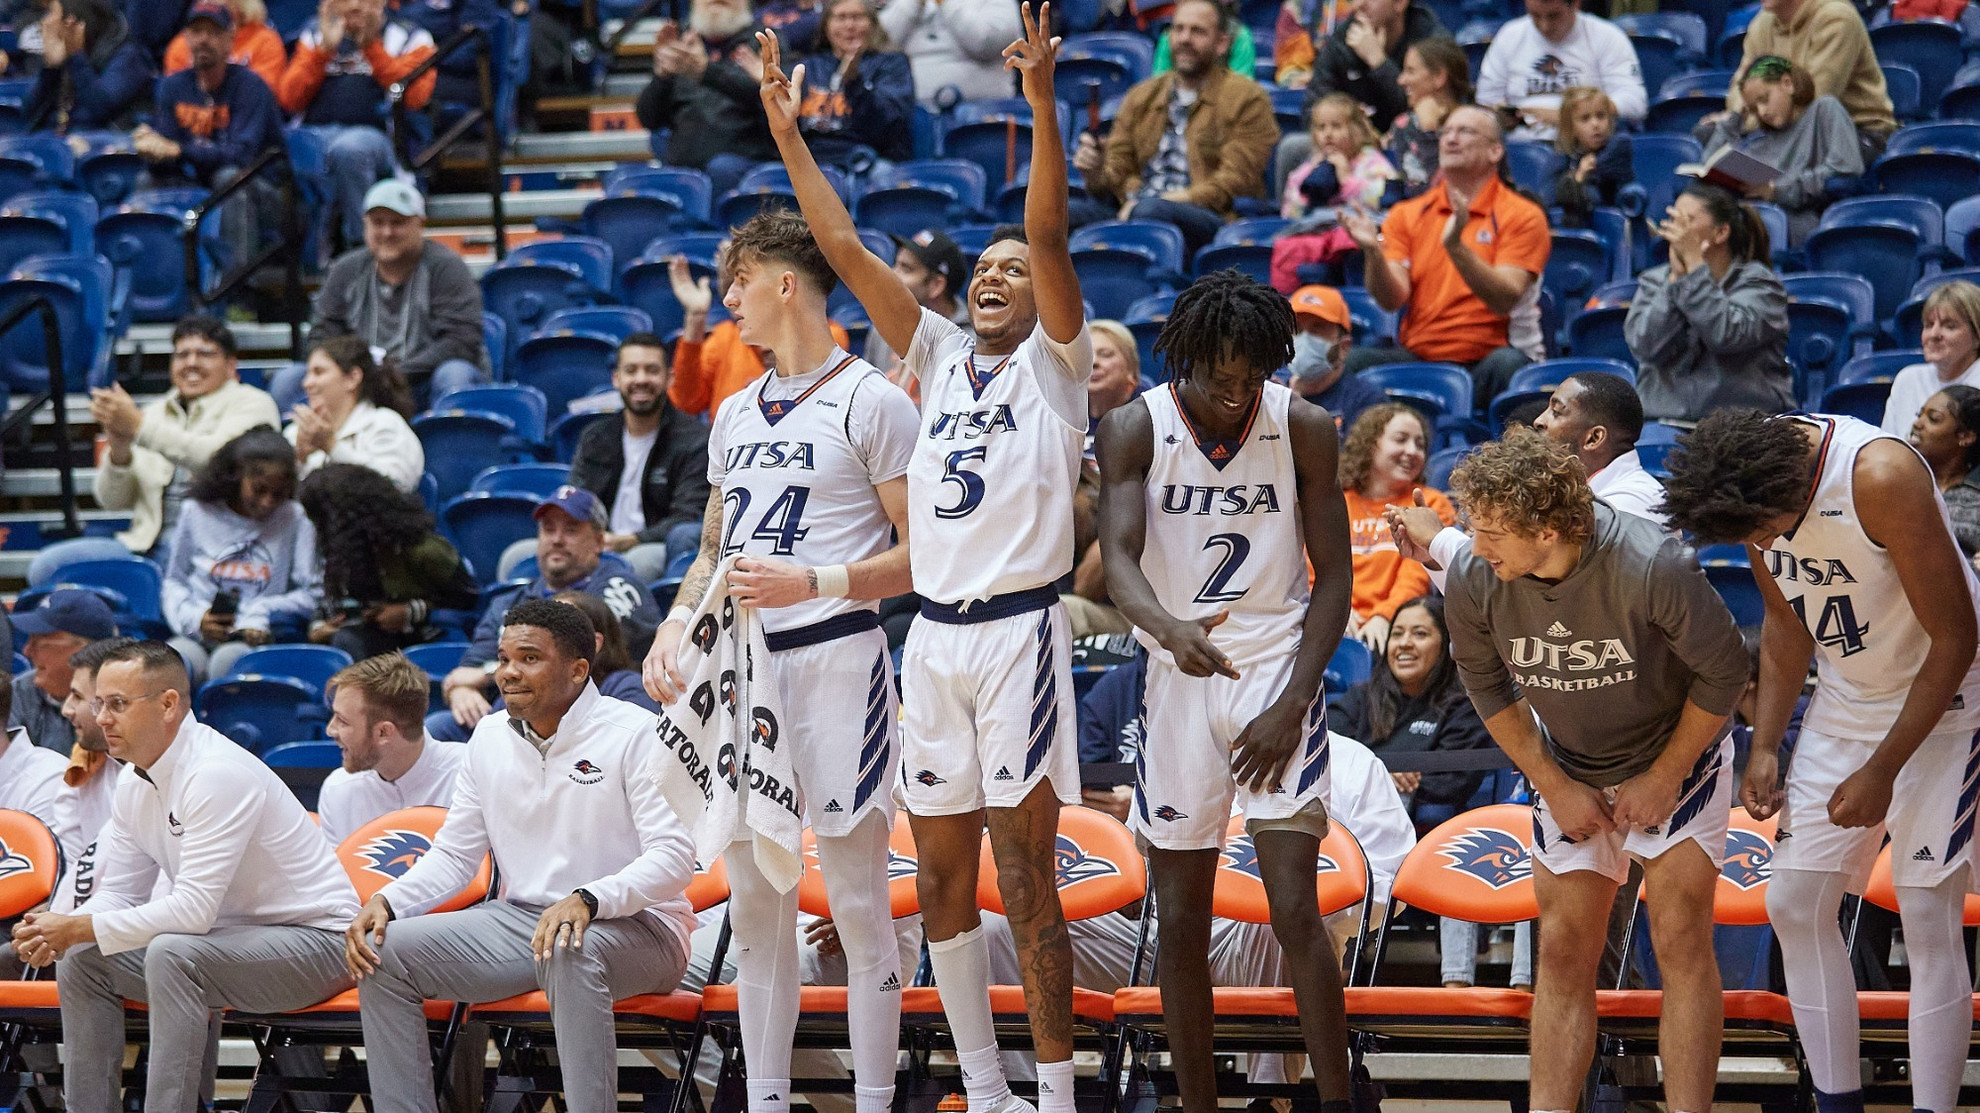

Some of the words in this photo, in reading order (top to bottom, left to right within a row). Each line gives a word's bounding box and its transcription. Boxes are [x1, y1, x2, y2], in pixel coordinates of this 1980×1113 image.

[929, 404, 1018, 440] UTSA
[724, 441, 815, 475] UTSA
[934, 446, 987, 519] 5
[1162, 484, 1281, 516] UTSA
[720, 485, 811, 561] 24
[1192, 533, 1251, 603] 2
[1508, 636, 1636, 672] UTSA
[1514, 670, 1638, 693] BASKETBALL
